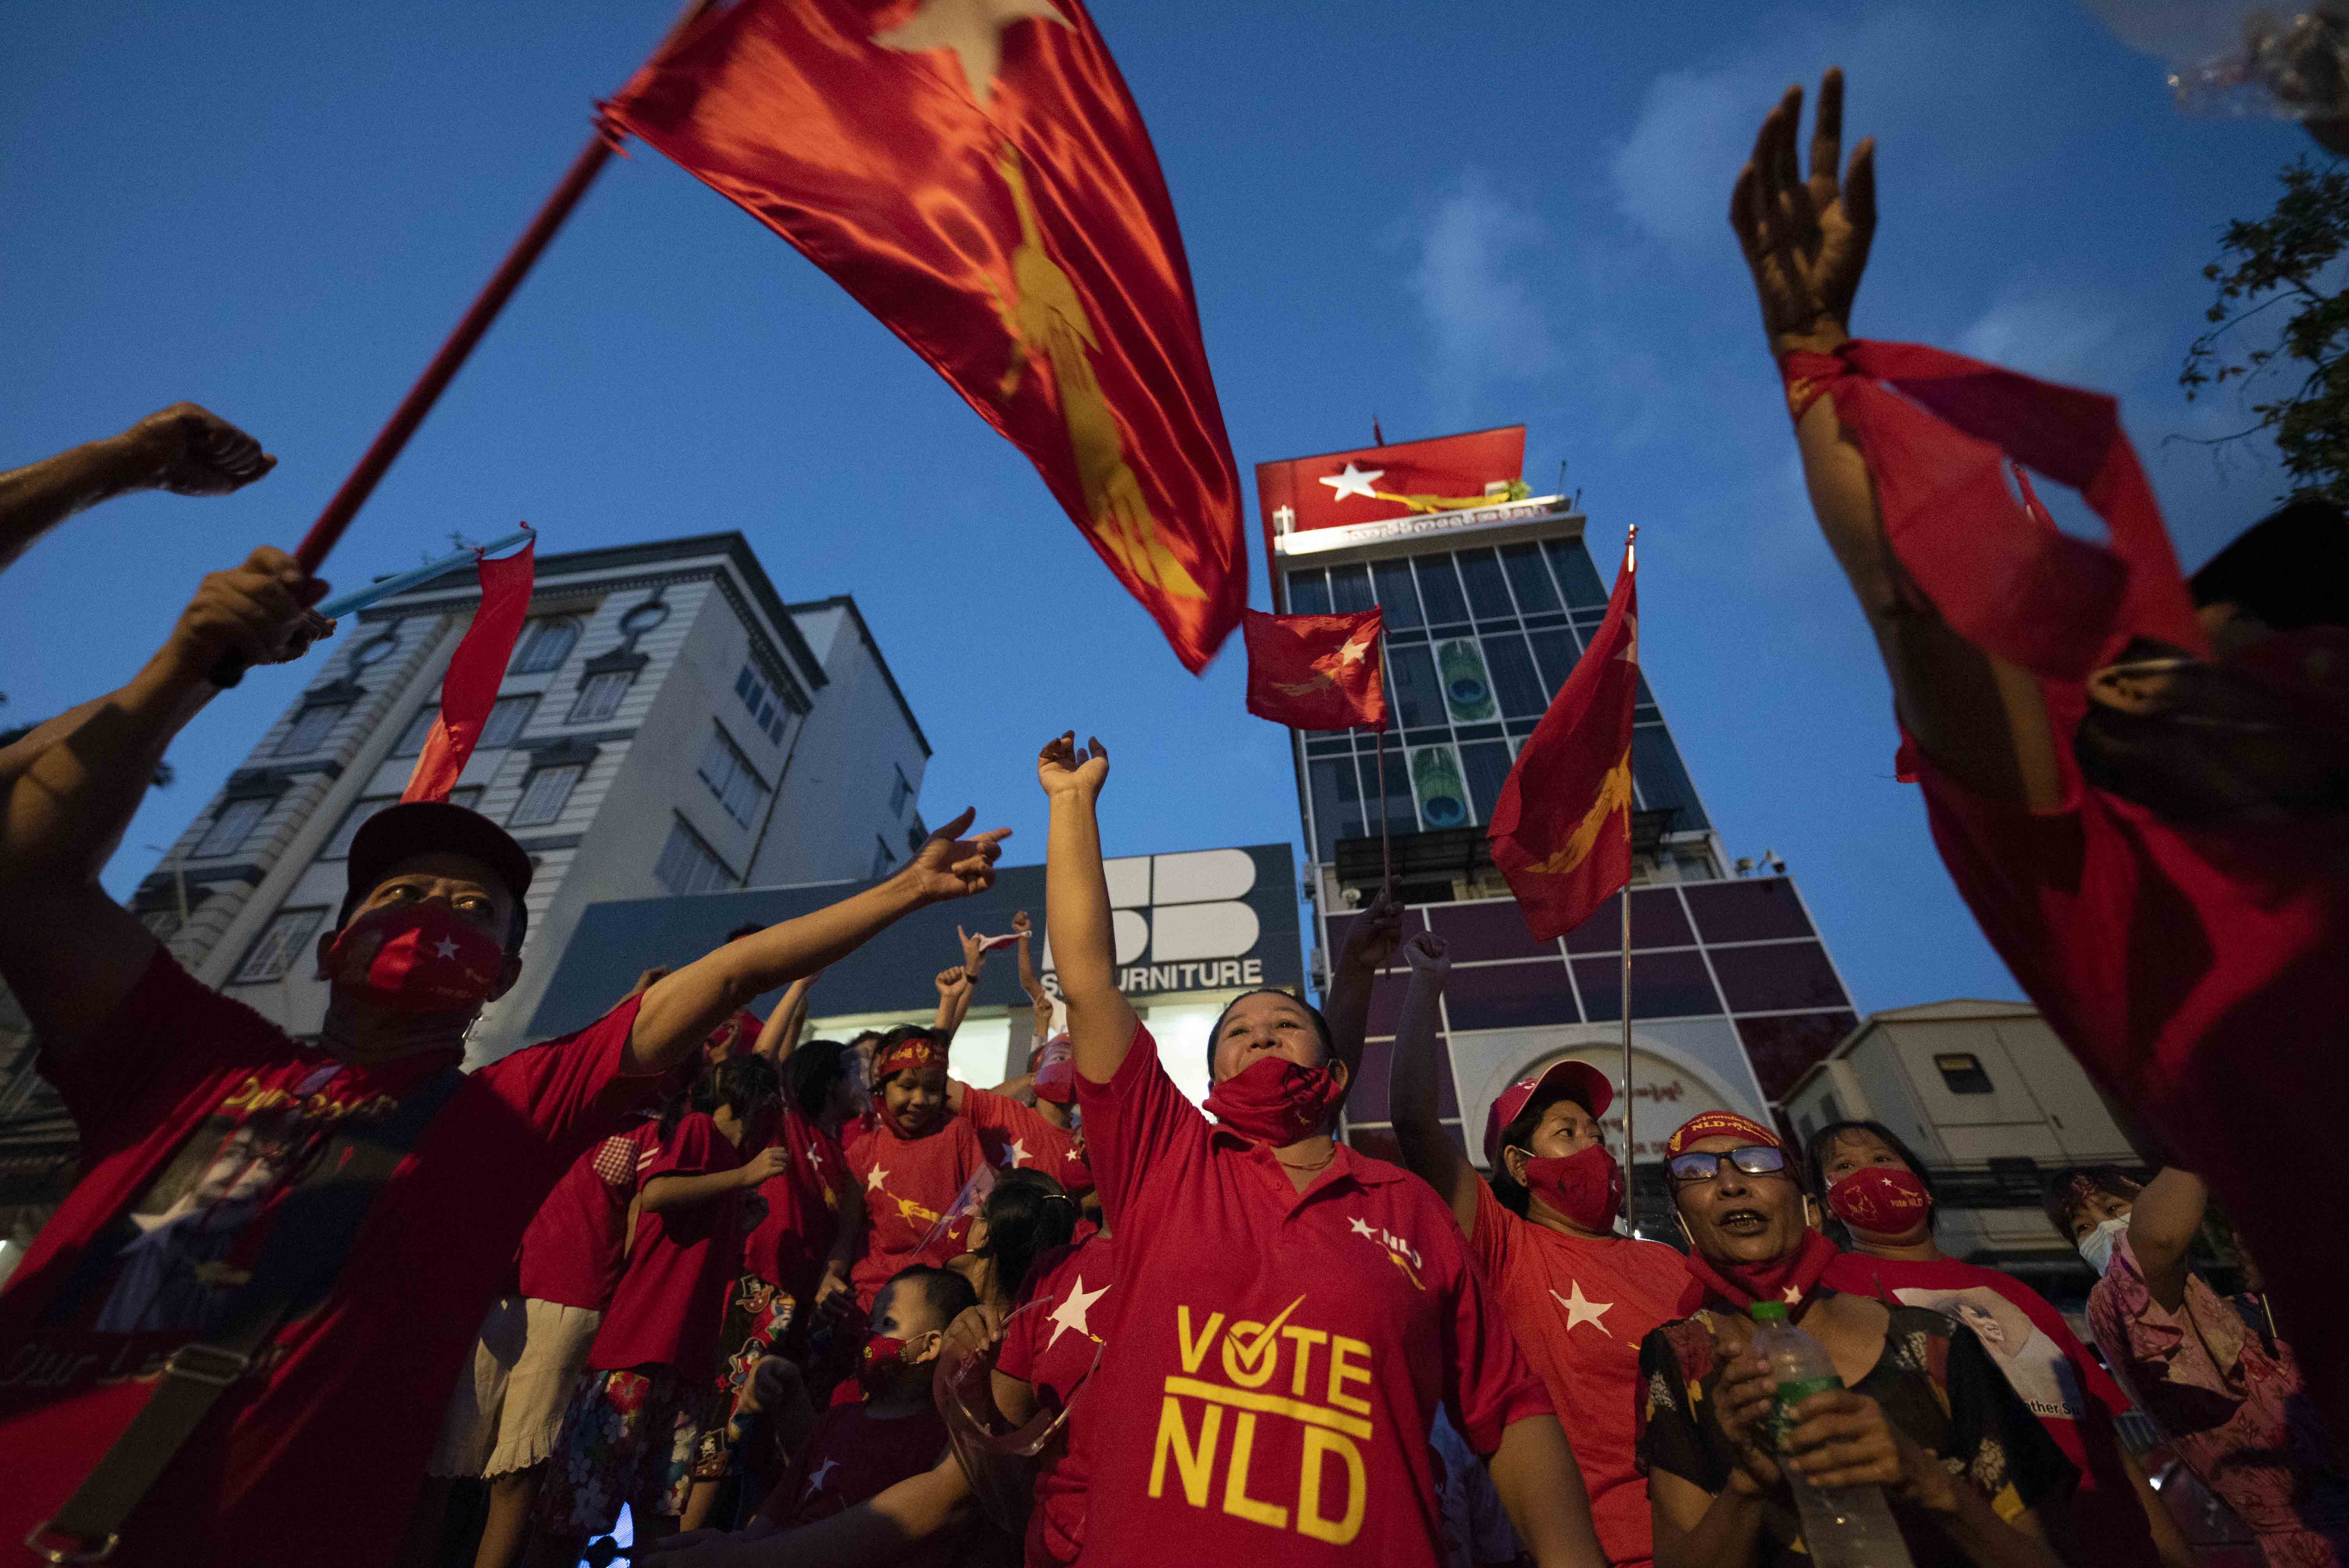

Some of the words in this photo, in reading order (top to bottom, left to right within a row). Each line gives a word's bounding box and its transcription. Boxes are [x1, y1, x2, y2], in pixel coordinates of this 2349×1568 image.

[1691, 1121, 1725, 1131] NLD
[1383, 1228, 1422, 1269] NLD
[1178, 1305, 1371, 1415] VOTE
[1148, 1395, 1366, 1545] NLD
